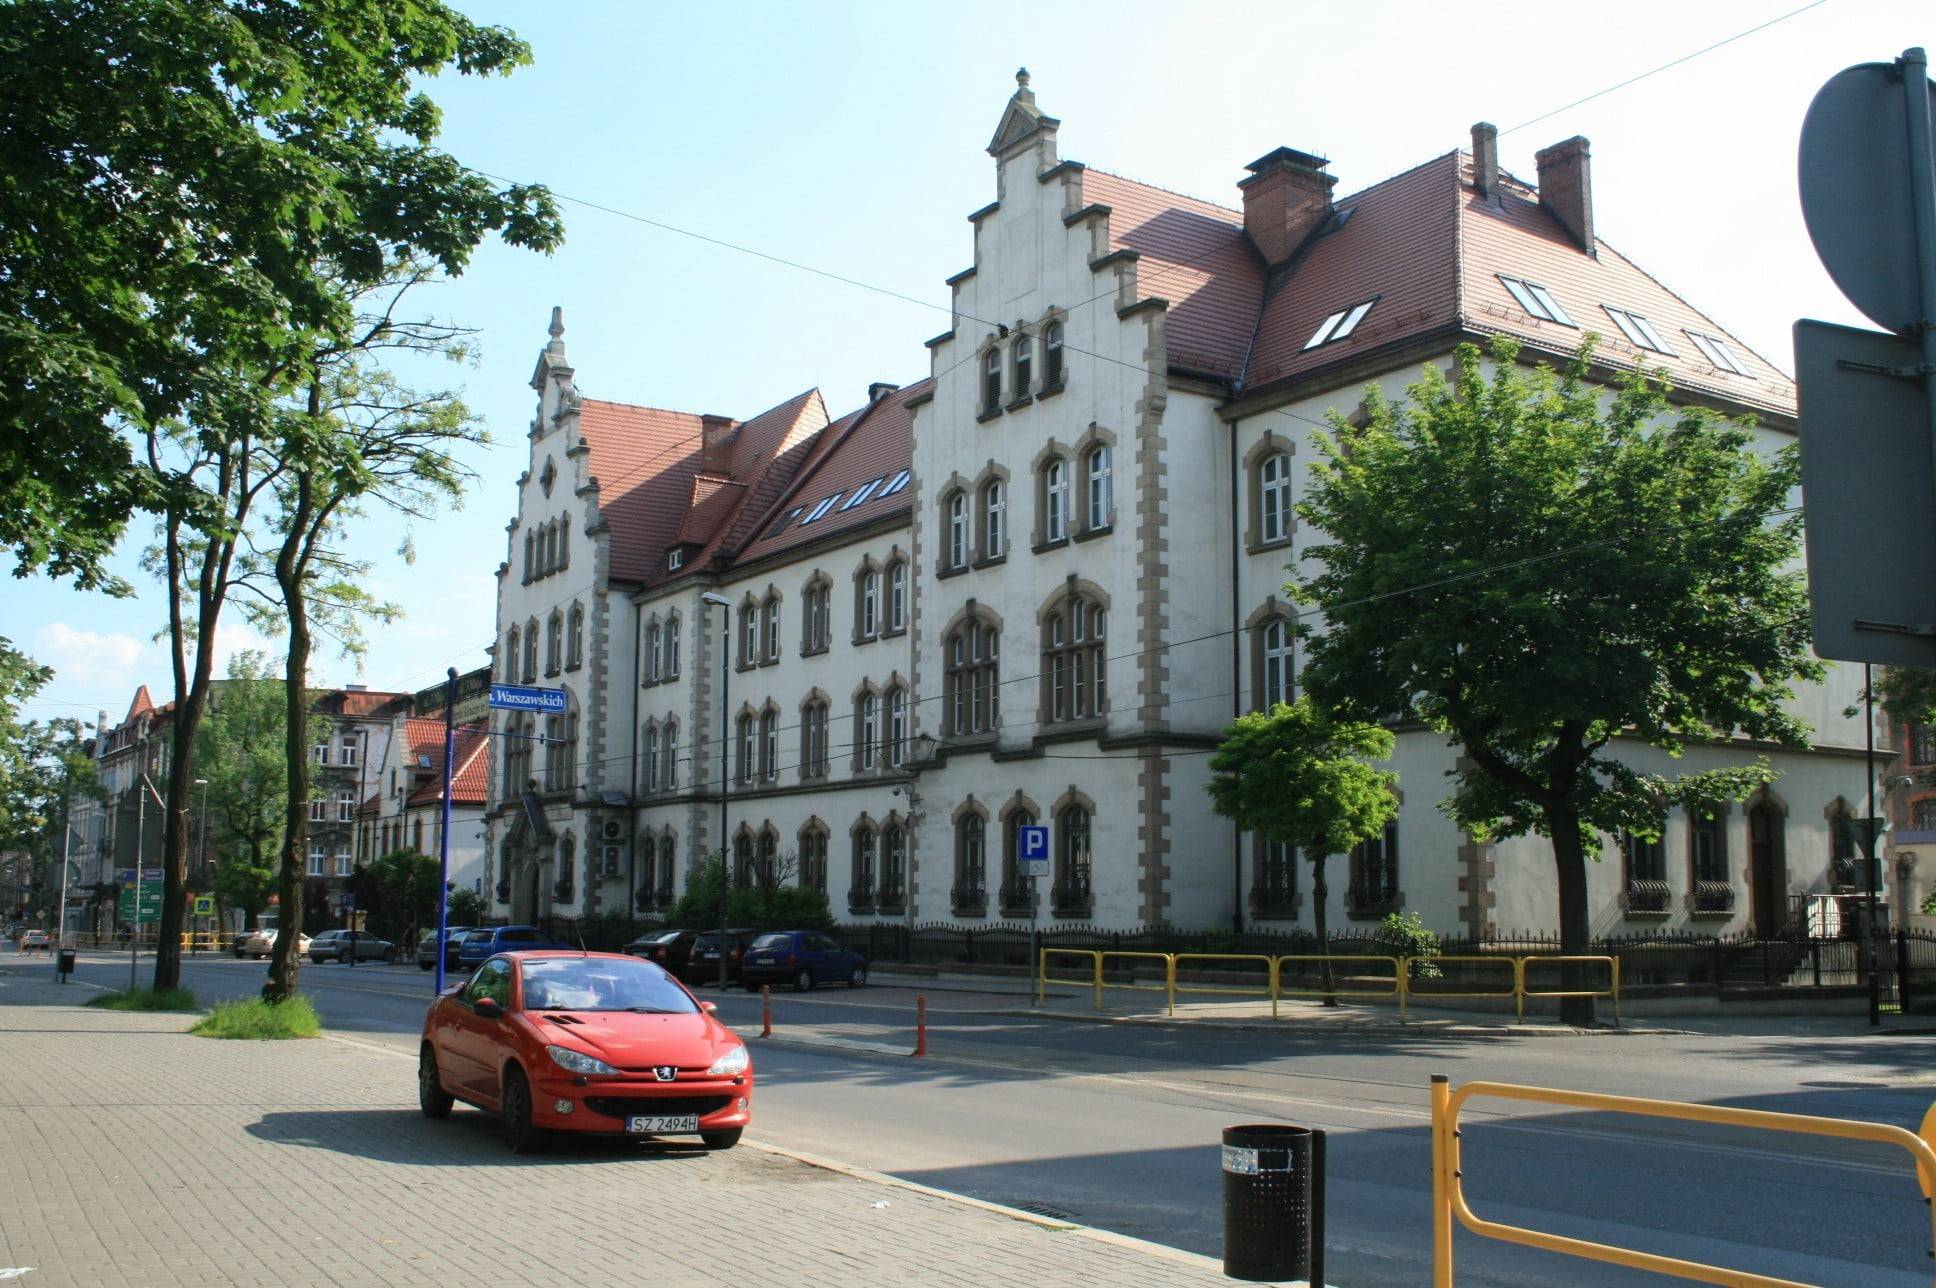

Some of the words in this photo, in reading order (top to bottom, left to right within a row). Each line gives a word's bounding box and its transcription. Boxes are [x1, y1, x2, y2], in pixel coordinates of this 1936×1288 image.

[497, 690, 563, 706] Warszawskich
[1027, 830, 1043, 855] P
[634, 1118, 653, 1131] SZ
[657, 1117, 697, 1131] 2494H
